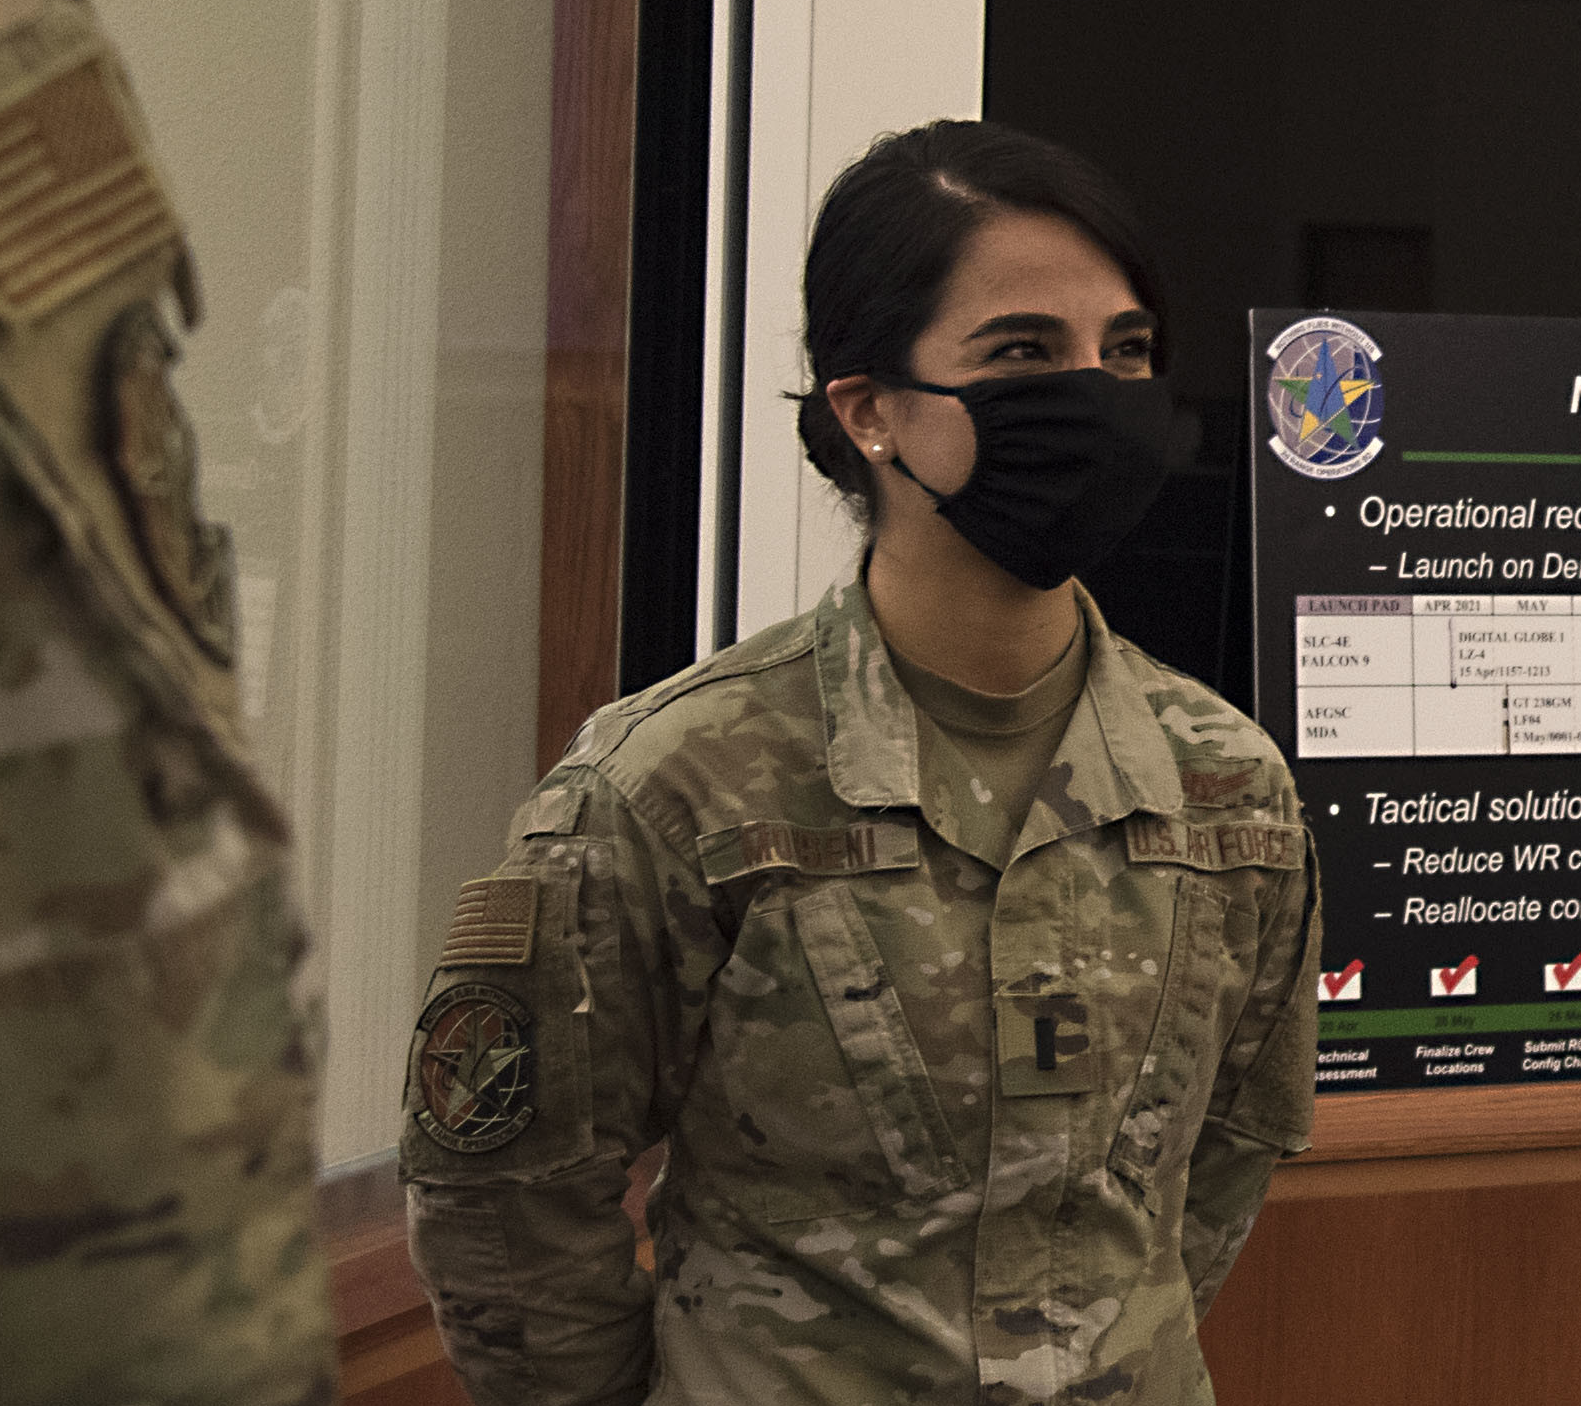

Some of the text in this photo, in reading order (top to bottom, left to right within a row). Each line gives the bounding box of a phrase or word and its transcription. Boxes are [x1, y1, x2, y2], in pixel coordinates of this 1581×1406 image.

[1360, 496, 1536, 534] Operational
[1398, 552, 1493, 578] Launch
[1502, 559, 1534, 579] on
[1309, 600, 1400, 612] LAUNCH PAD
[1424, 600, 1481, 612] APR 2021
[1517, 600, 1548, 612] MAY
[1304, 636, 1351, 648] SLC-4E
[1459, 632, 1509, 643] DIGITAL
[1514, 632, 1557, 643] GLOBE
[1301, 655, 1370, 667] FALCON 9
[1459, 649, 1485, 660] LZ-4
[1305, 706, 1352, 719] AFGSC
[1305, 726, 1338, 738] MDA
[1366, 792, 1480, 824] Tactical
[1132, 821, 1182, 858] U.S.
[1216, 824, 1293, 865] FORCE
[1403, 847, 1503, 874] Reduce
[1514, 844, 1560, 871] WR
[1404, 896, 1541, 924] Reallocate
[1416, 1044, 1495, 1059] Finalize Crew
[1524, 1040, 1566, 1053] Submit
[1318, 1048, 1370, 1063] echnical
[1426, 1062, 1486, 1076] Locations
[1522, 1057, 1561, 1073] Config
[1315, 1066, 1378, 1082] ssessment
